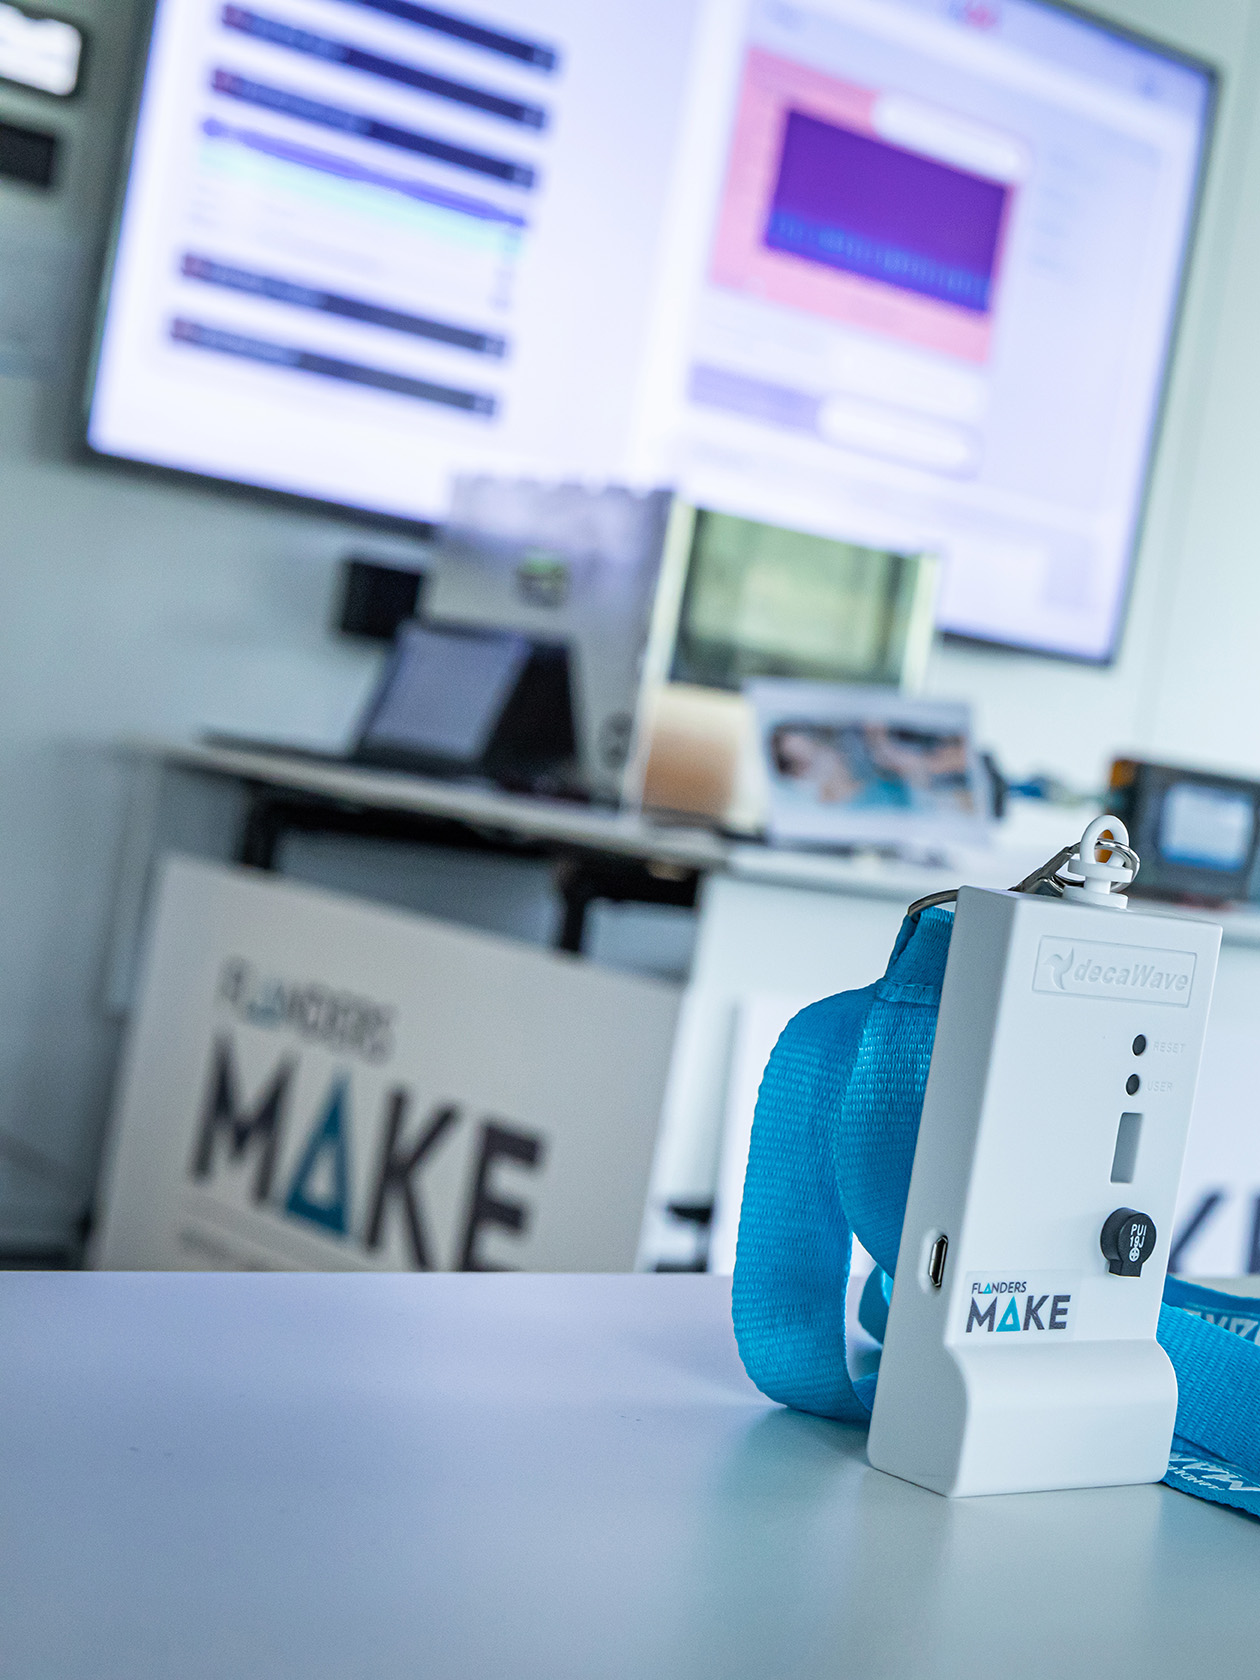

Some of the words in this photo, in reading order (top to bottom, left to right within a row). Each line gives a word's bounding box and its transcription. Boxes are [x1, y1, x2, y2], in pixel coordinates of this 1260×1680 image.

[1074, 959, 1189, 992] decaWave
[1153, 1041, 1186, 1054] RESET
[1147, 1081, 1174, 1092] USER
[189, 1026, 549, 1271] MAKE
[1130, 1223, 1147, 1236] PUI
[1130, 1235, 1145, 1248] 19J
[972, 1281, 1027, 1294] FLANDERS
[966, 1294, 1071, 1333] MAKE
